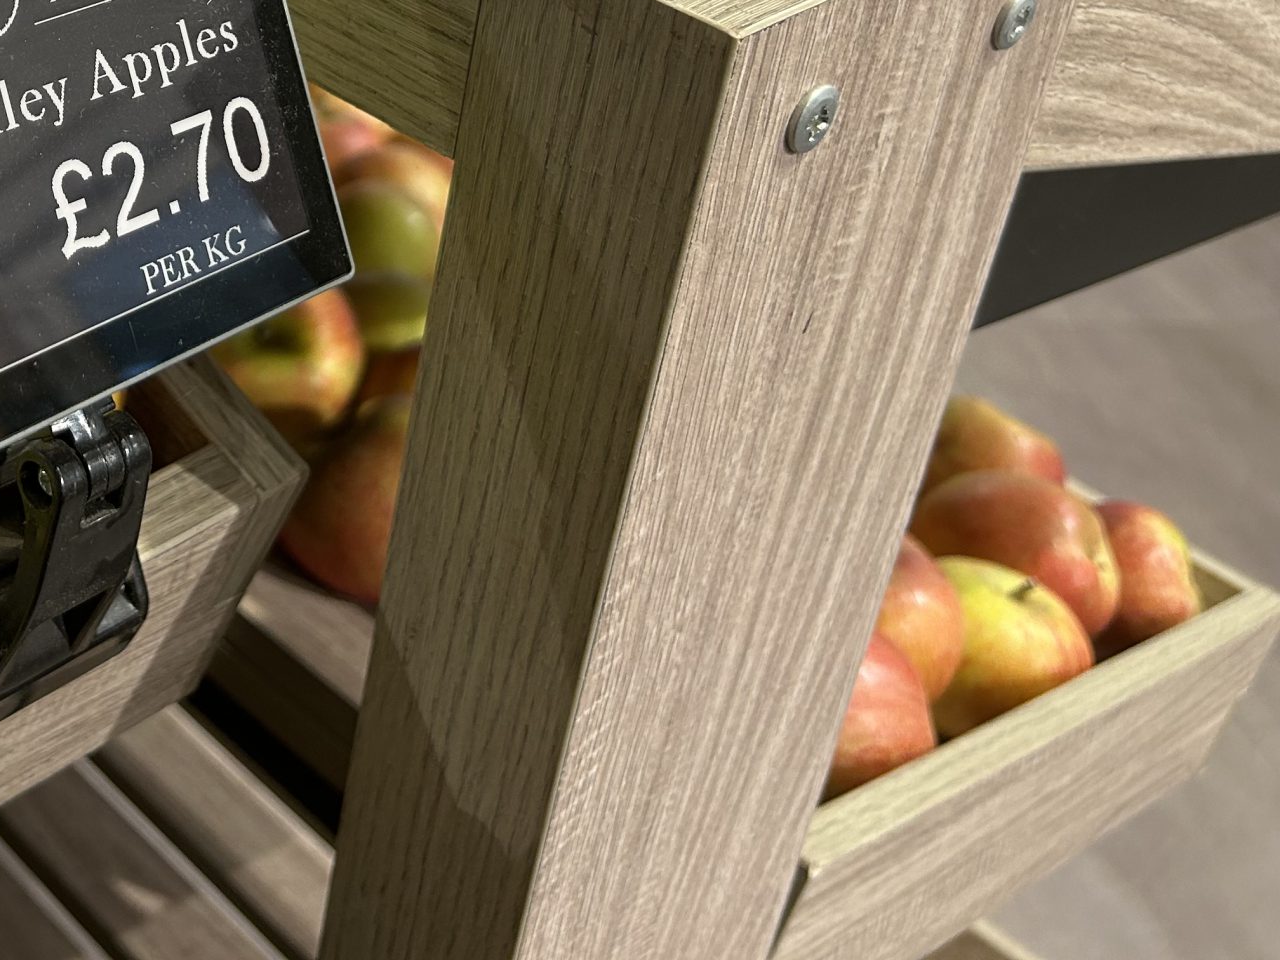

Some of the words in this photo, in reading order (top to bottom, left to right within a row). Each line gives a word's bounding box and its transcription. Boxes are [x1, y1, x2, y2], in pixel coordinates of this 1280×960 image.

[90, 19, 239, 100] Apples
[51, 96, 271, 260] £2.70
[140, 246, 202, 296] PER
[202, 225, 248, 268] KG
